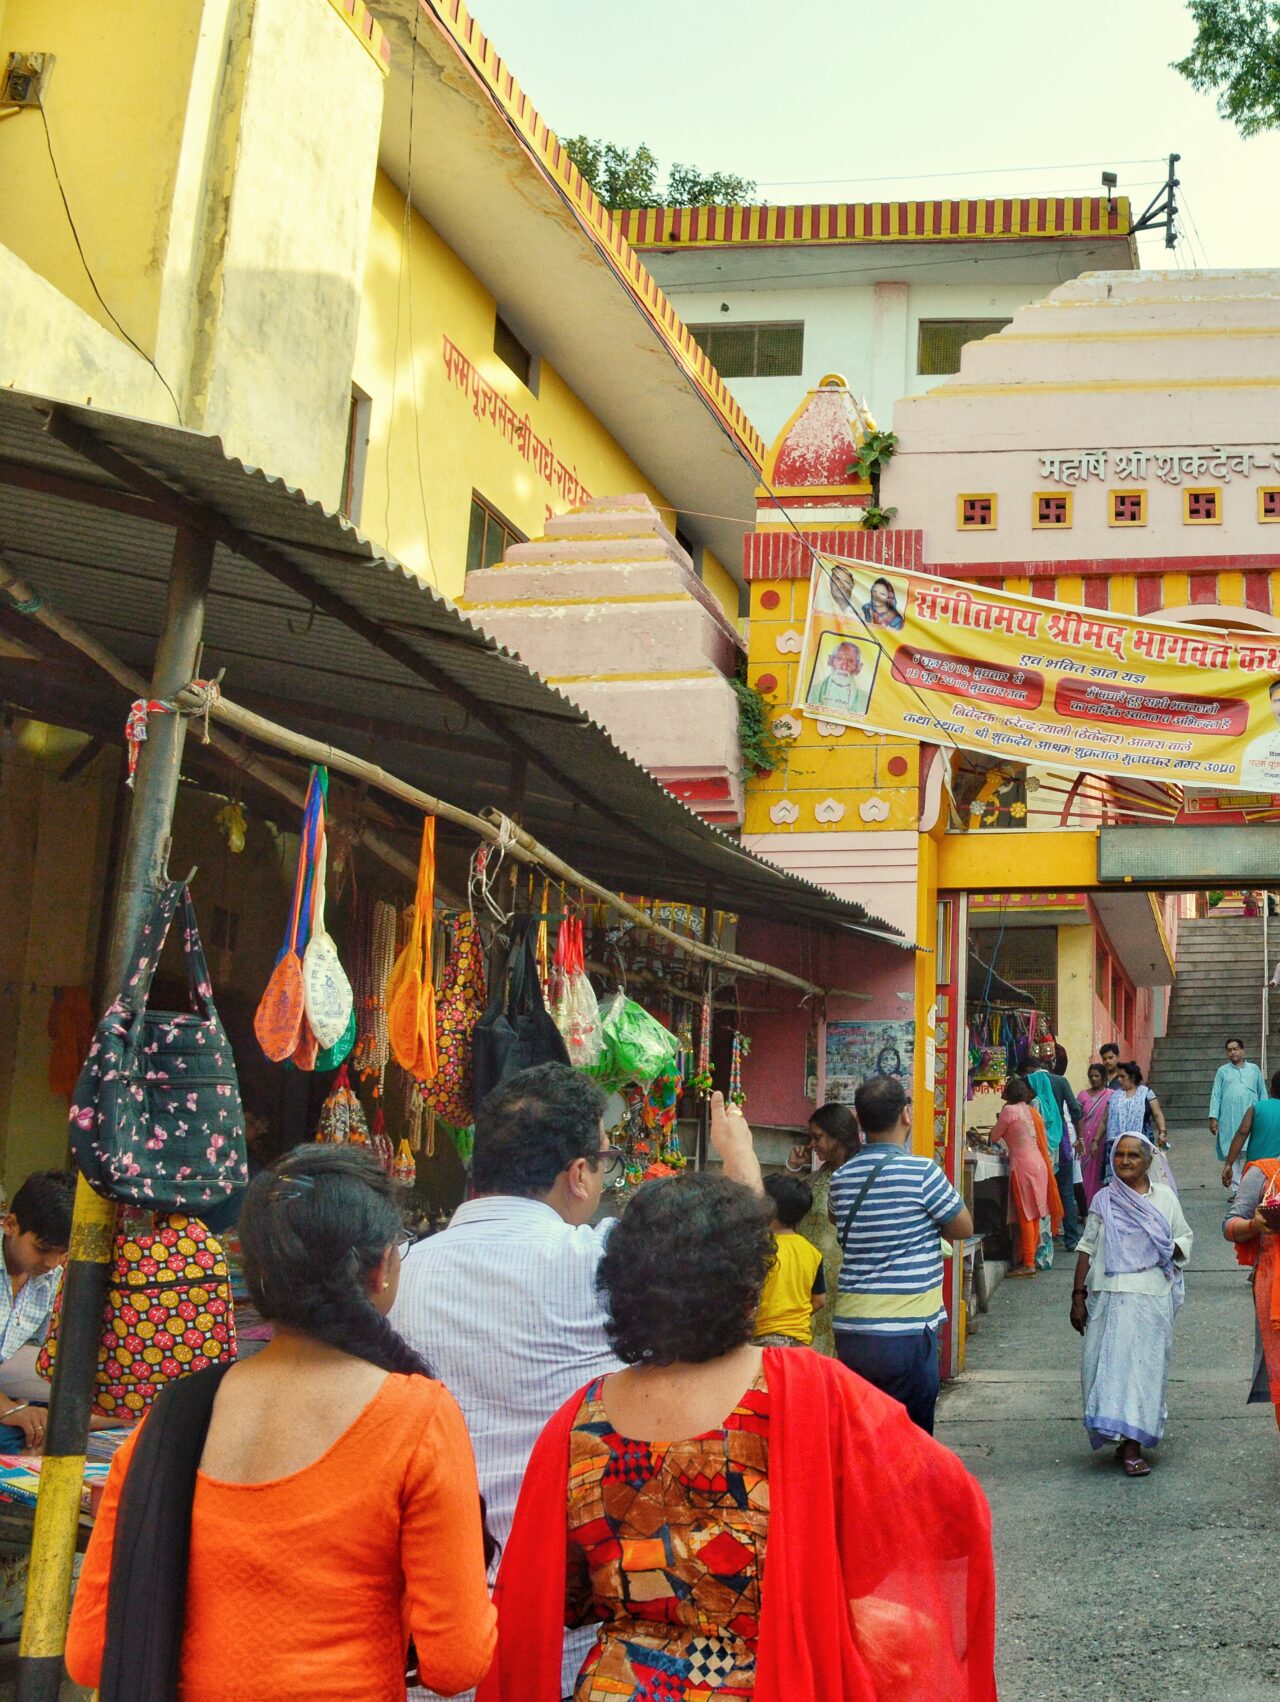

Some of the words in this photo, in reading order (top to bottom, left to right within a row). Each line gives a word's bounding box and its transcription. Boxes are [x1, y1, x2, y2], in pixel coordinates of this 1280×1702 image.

[443, 333, 472, 398] परम
[472, 366, 499, 427] पूज्य
[1039, 450, 1108, 486] महर्षि
[1114, 450, 1152, 481] श्री
[914, 587, 1042, 637] संगीतमय
[1047, 612, 1128, 662] श्रीमद्
[1132, 628, 1234, 669] भागवत
[905, 668, 918, 678] 13
[921, 671, 939, 684] जून
[941, 676, 967, 689] 2018
[969, 682, 1006, 697] बुधवार
[1006, 688, 1027, 700] तक
[912, 654, 920, 663] 6
[921, 656, 941, 670] जून
[973, 667, 1009, 682] बुधवार
[1012, 672, 1024, 685] से
[1019, 654, 1045, 667] एवं
[1045, 657, 1086, 674] भक्ति
[1089, 667, 1117, 680] ज्ञान
[1120, 672, 1146, 684] यज्ञ
[1070, 701, 1086, 712] का
[1087, 703, 1123, 718] हार्दिक
[1123, 710, 1161, 723] स्वागत
[903, 713, 931, 726] कथा
[991, 731, 1033, 745] शुकदेव
[1034, 740, 1072, 755] आश्रम
[1173, 759, 1202, 771] नगर
[1004, 716, 1037, 732] हरेन्द्र
[1038, 723, 1073, 738] त्यागी
[1127, 737, 1166, 751] आगरा
[1167, 741, 1193, 753] वाले
